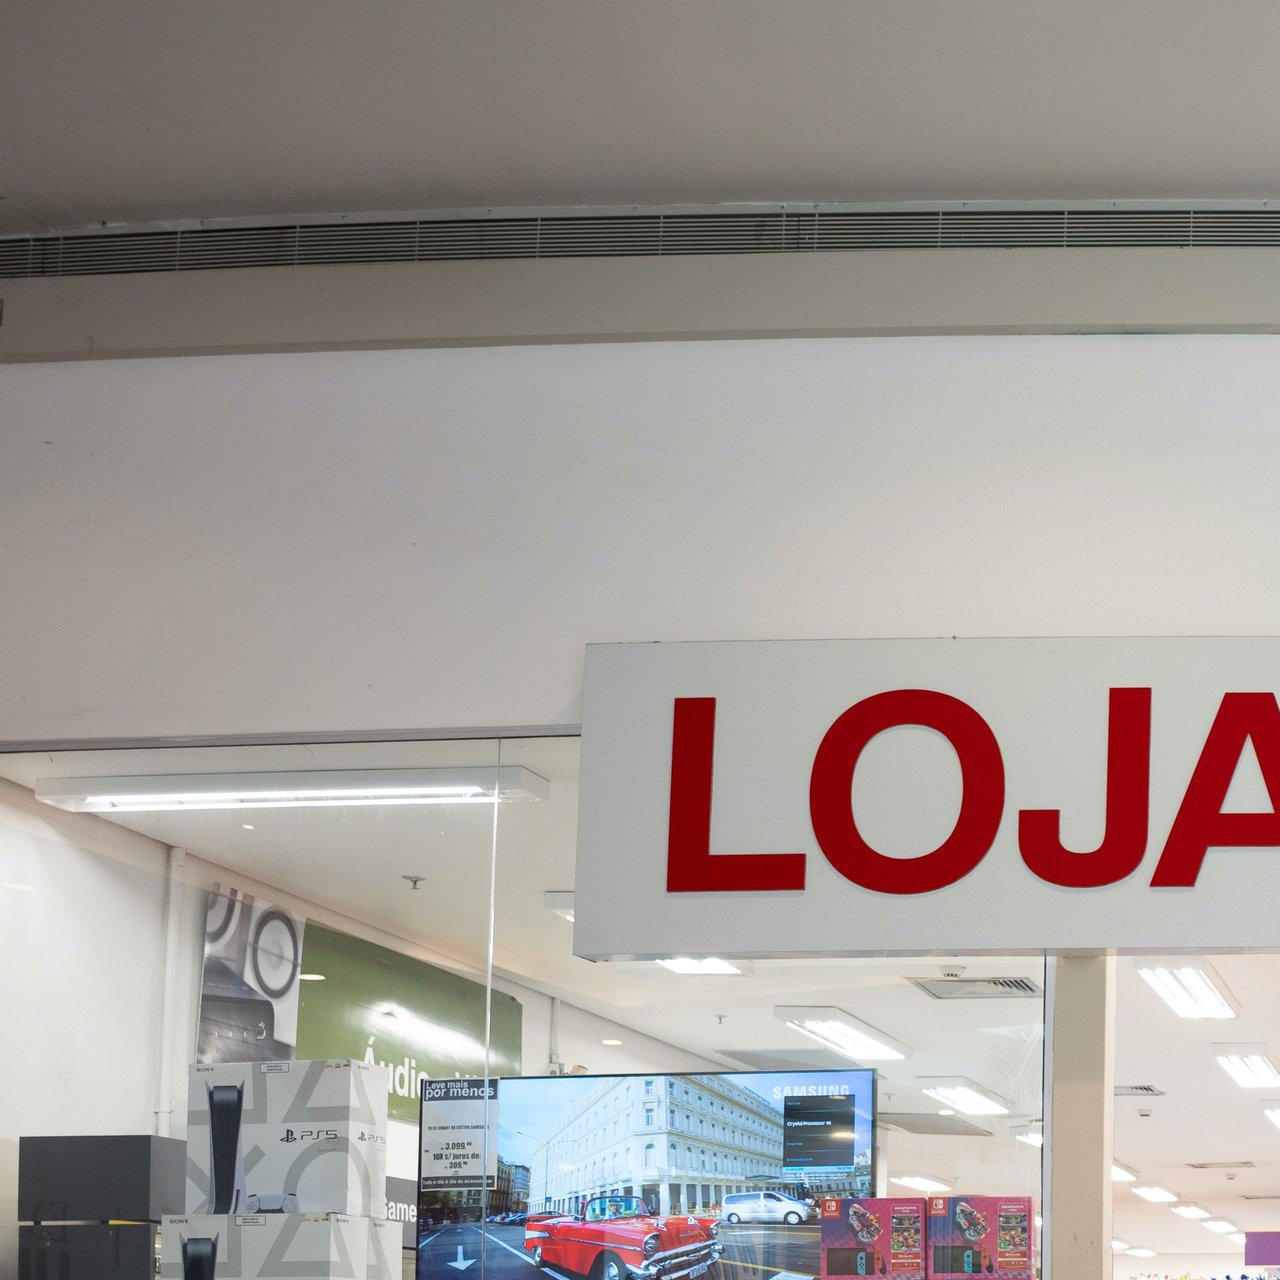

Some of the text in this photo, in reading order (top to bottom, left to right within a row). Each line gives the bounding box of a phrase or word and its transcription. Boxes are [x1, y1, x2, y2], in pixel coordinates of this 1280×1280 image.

[426, 1081, 468, 1090] Leve mais
[425, 1086, 494, 1101] por menos
[773, 1085, 849, 1099] SAMSUNG
[301, 1129, 338, 1140] PS5
